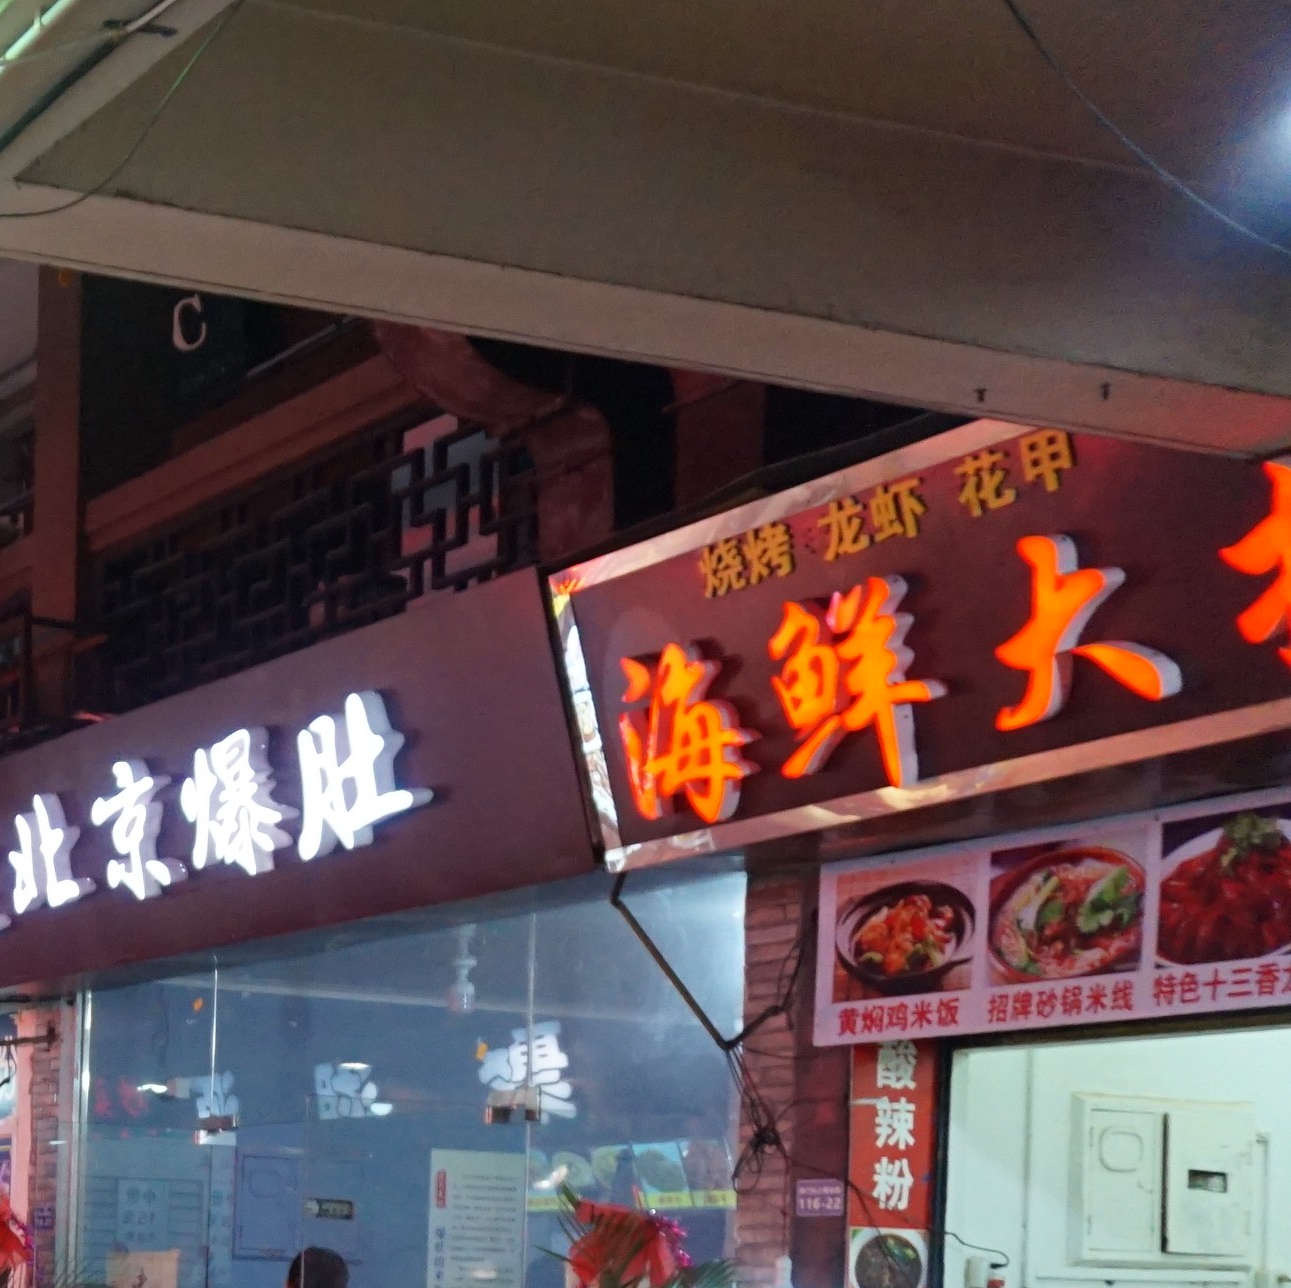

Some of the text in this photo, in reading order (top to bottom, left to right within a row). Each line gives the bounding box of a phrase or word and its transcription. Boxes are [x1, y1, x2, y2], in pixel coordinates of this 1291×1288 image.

[699, 430, 1078, 599] 烧烤 龙虾 花甲
[838, 997, 960, 1037] 黄焖鸡米饭
[988, 981, 1135, 1025] 招牌砂锅米线
[872, 1040, 917, 1211] 酸辣粉
